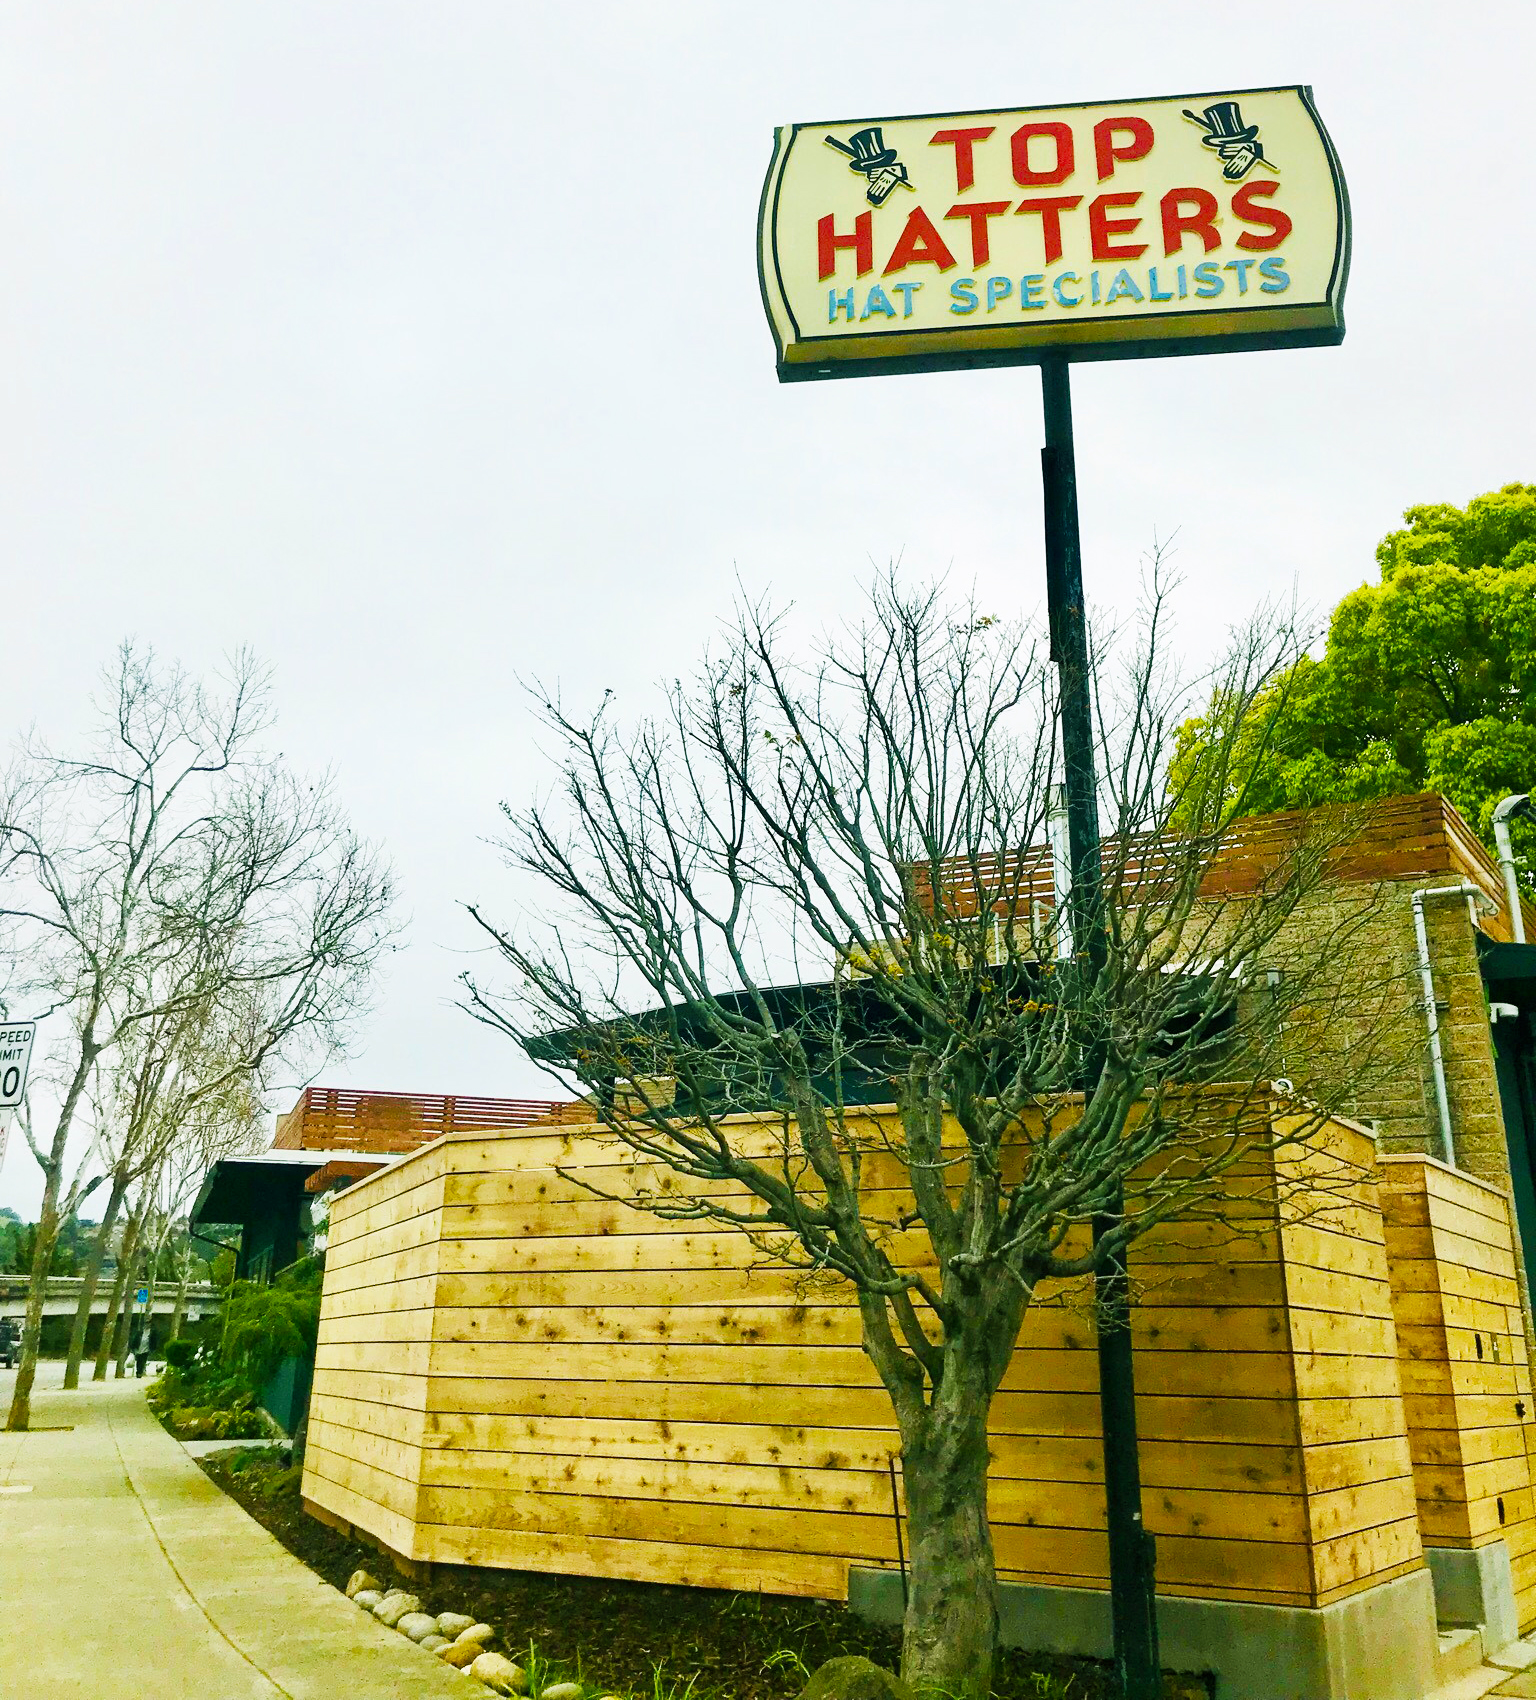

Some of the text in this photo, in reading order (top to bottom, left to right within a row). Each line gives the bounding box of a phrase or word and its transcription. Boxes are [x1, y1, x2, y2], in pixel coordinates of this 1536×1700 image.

[929, 117, 1155, 195] TOP
[817, 180, 1293, 281] HATTERS
[828, 257, 1292, 324] HAT SPECIALISTS
[0, 1030, 31, 1042] PEED
[0, 1048, 23, 1060] IMIT
[0, 1066, 20, 1097] 0
